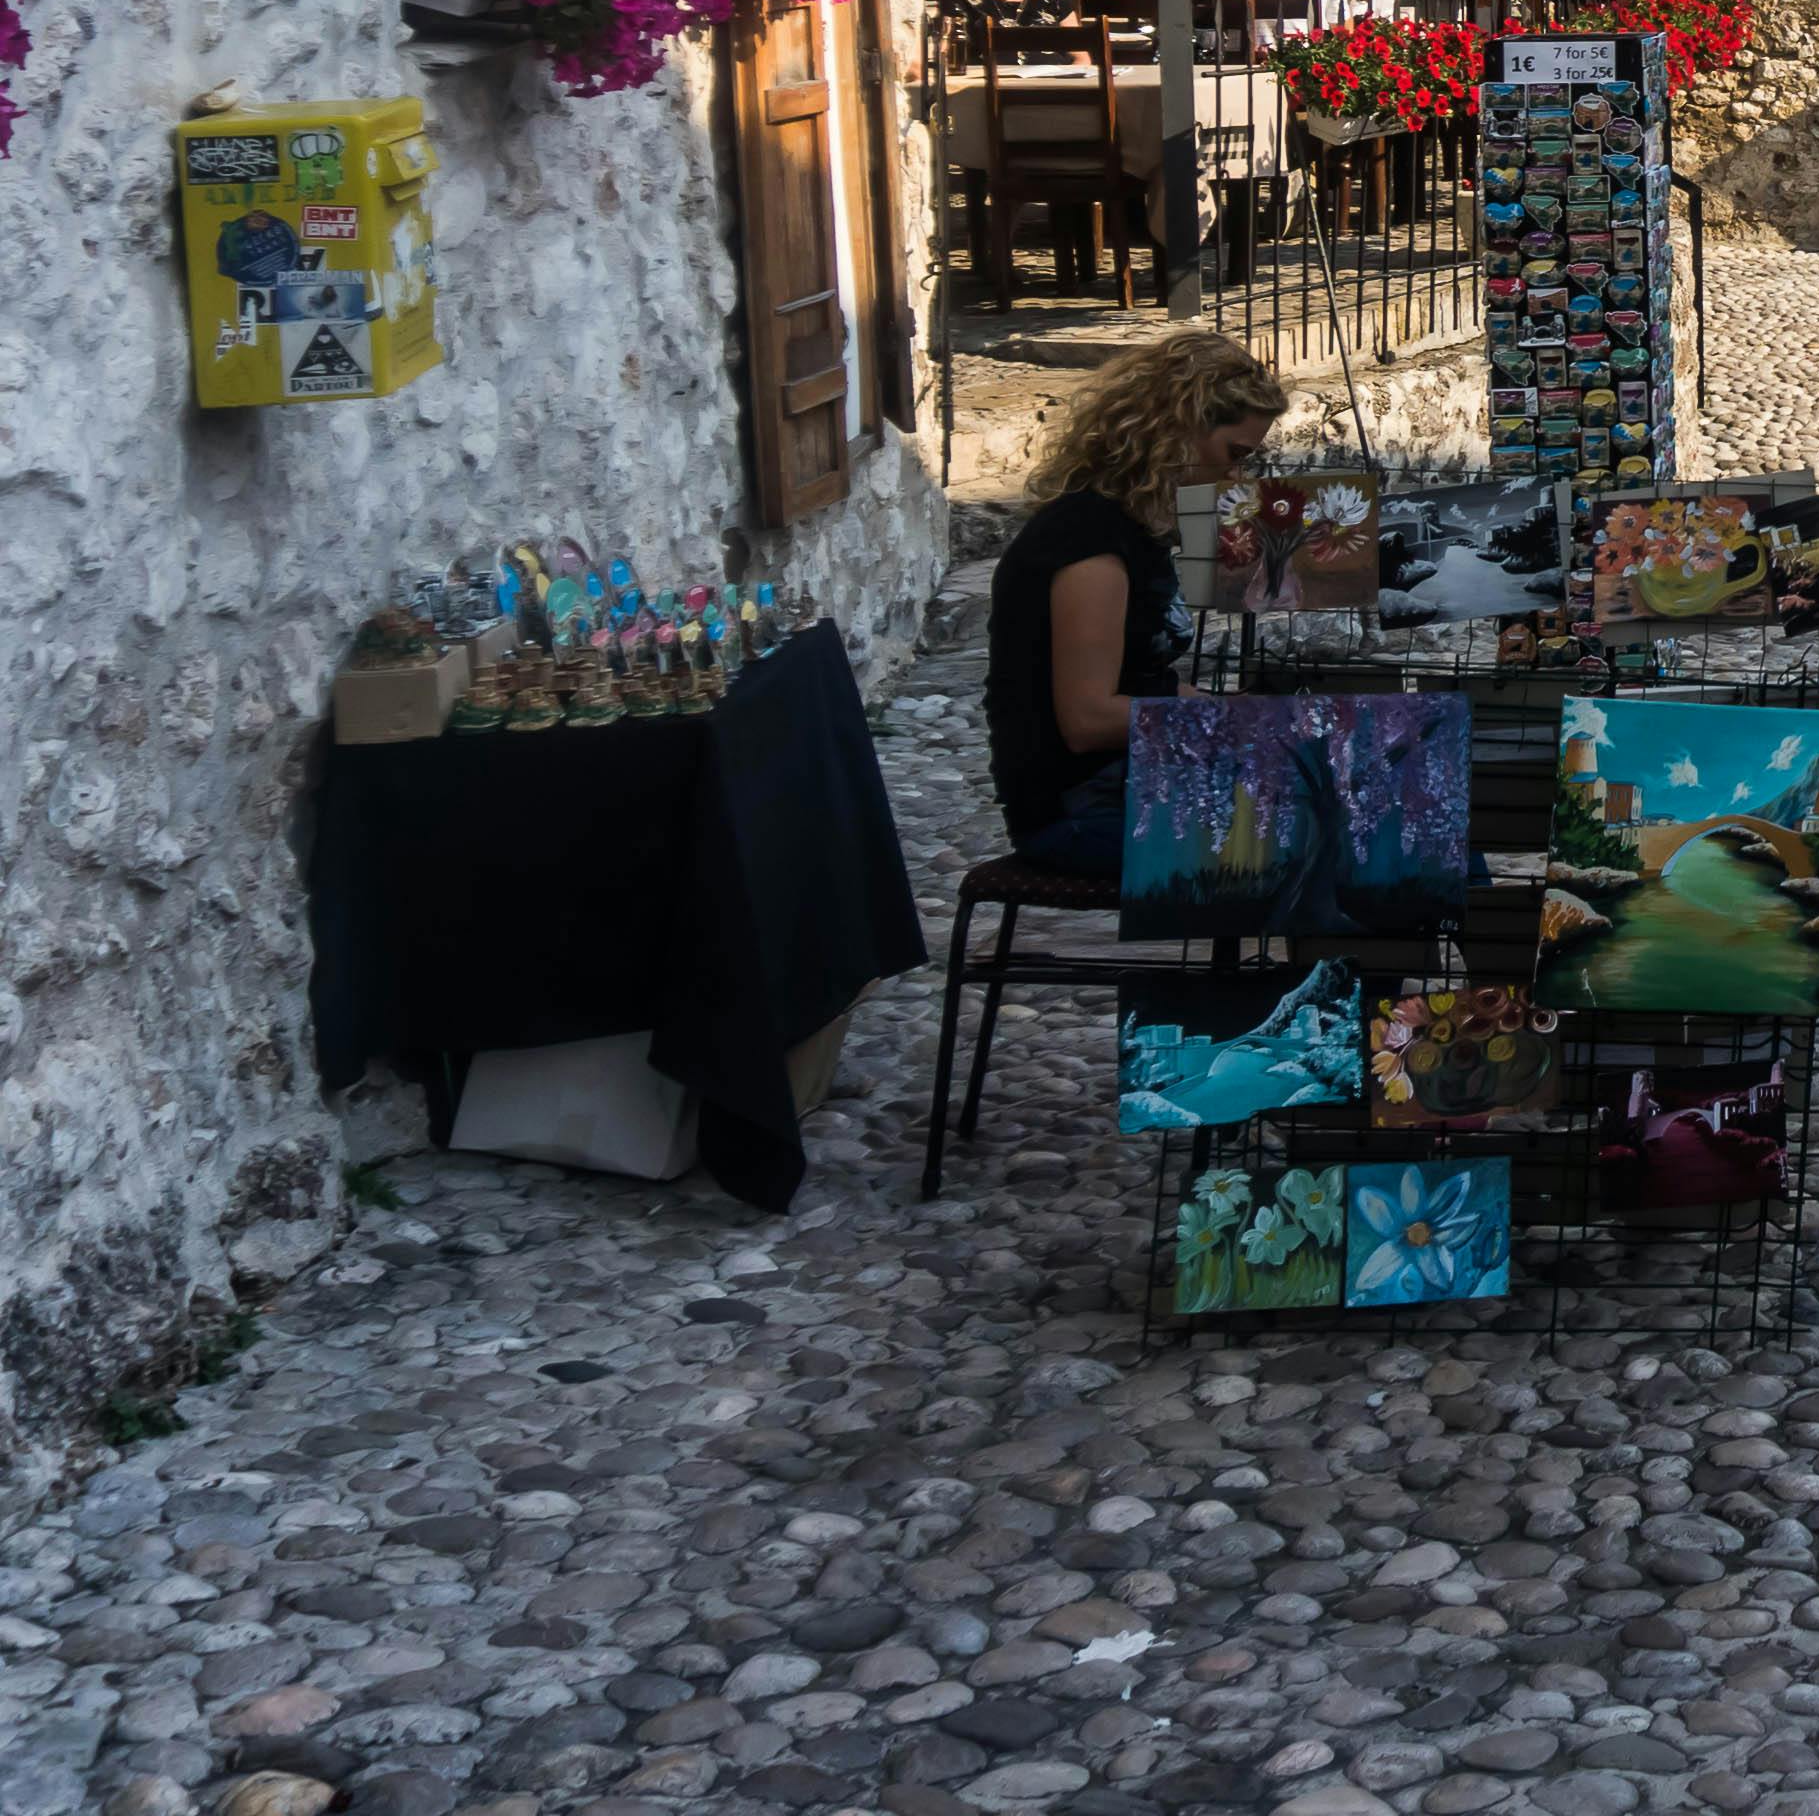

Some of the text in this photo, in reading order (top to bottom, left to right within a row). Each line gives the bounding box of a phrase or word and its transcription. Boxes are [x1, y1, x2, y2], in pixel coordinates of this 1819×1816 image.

[1553, 46, 1608, 59] 7 for 5€
[1511, 55, 1536, 73] 1€
[1553, 67, 1562, 80] 3
[1565, 66, 1587, 80] for
[307, 209, 354, 222] BNT
[306, 225, 355, 238] BNT
